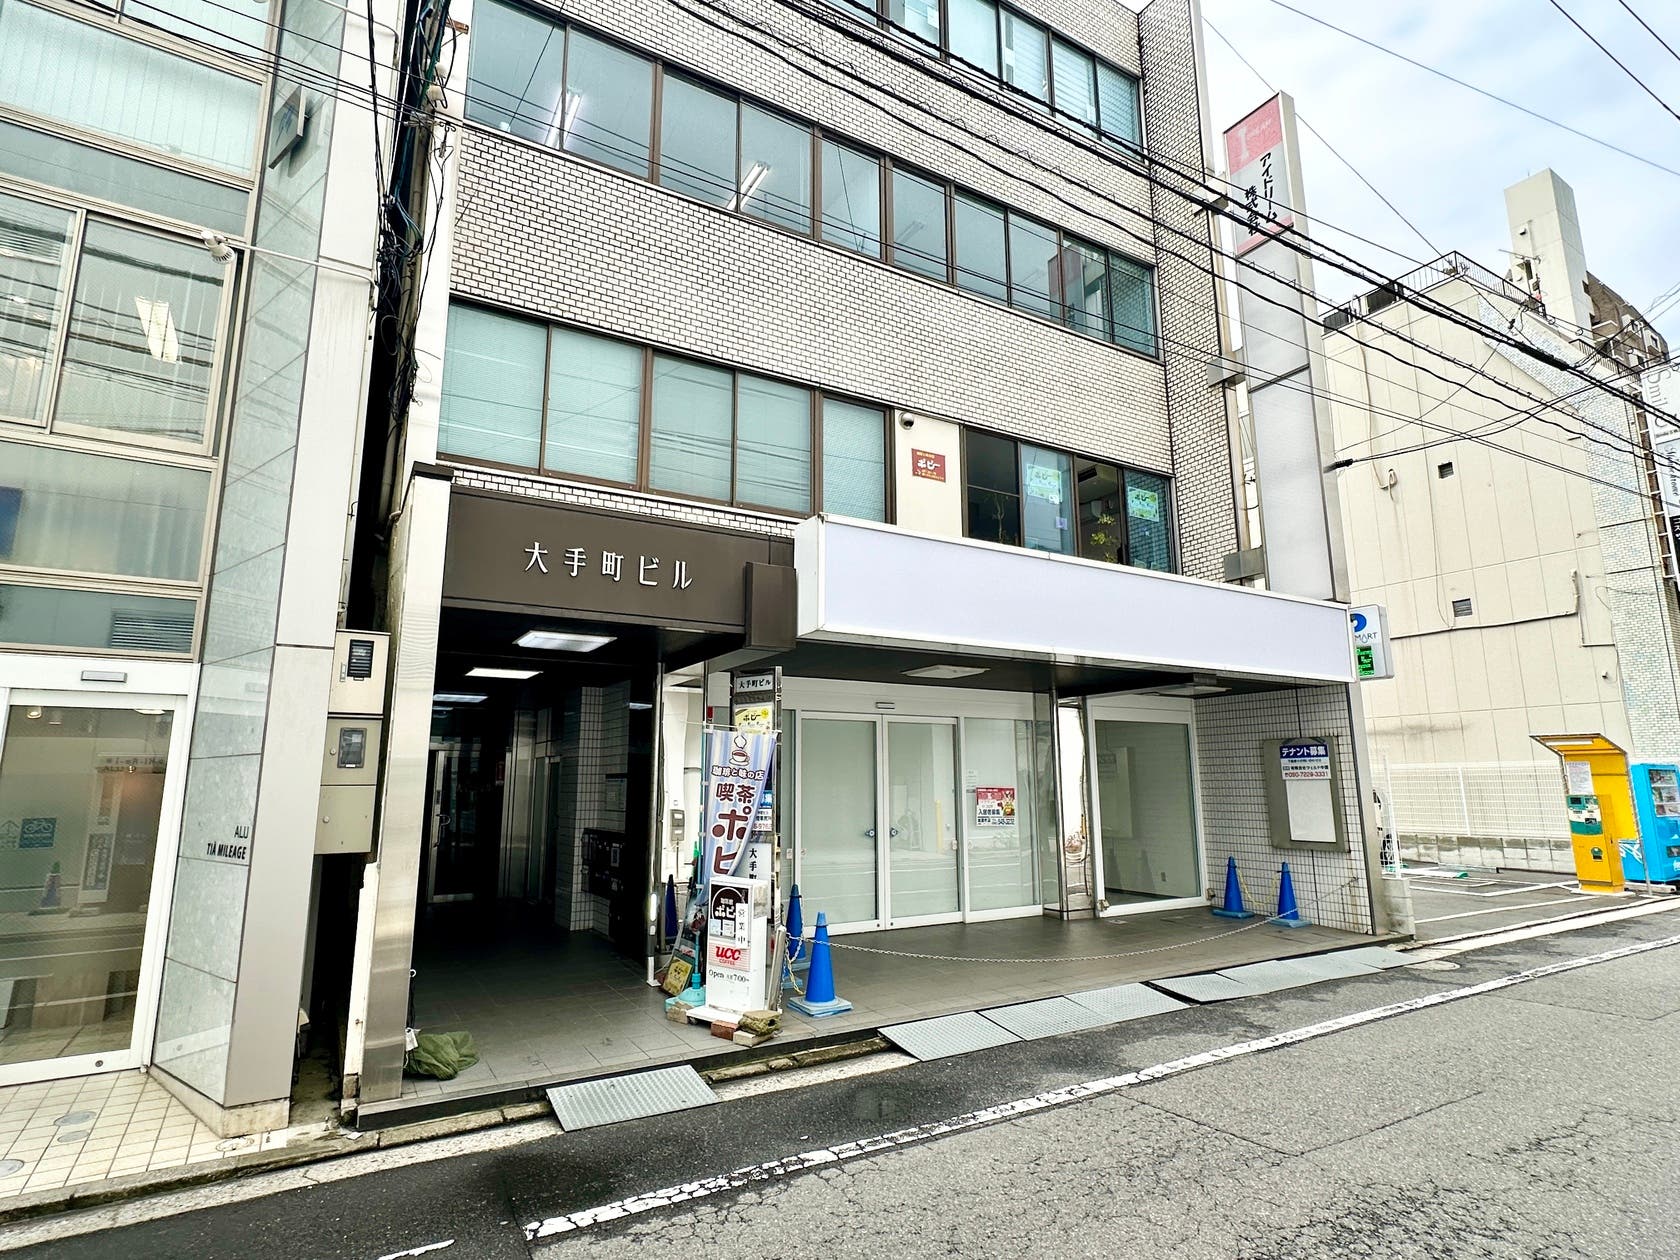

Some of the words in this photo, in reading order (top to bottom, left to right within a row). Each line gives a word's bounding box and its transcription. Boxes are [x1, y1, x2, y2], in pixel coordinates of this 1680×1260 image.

[524, 541, 693, 589] 大手町ビル
[739, 678, 771, 689] 大手町ビル
[1282, 746, 1326, 757] テナント募集
[711, 765, 765, 780] 珈琲と味の店
[716, 783, 755, 803] 喫茶
[234, 825, 249, 839] ALU
[217, 843, 247, 859] MILEAGE
[715, 946, 741, 960] UCC
[709, 969, 724, 979] Open
